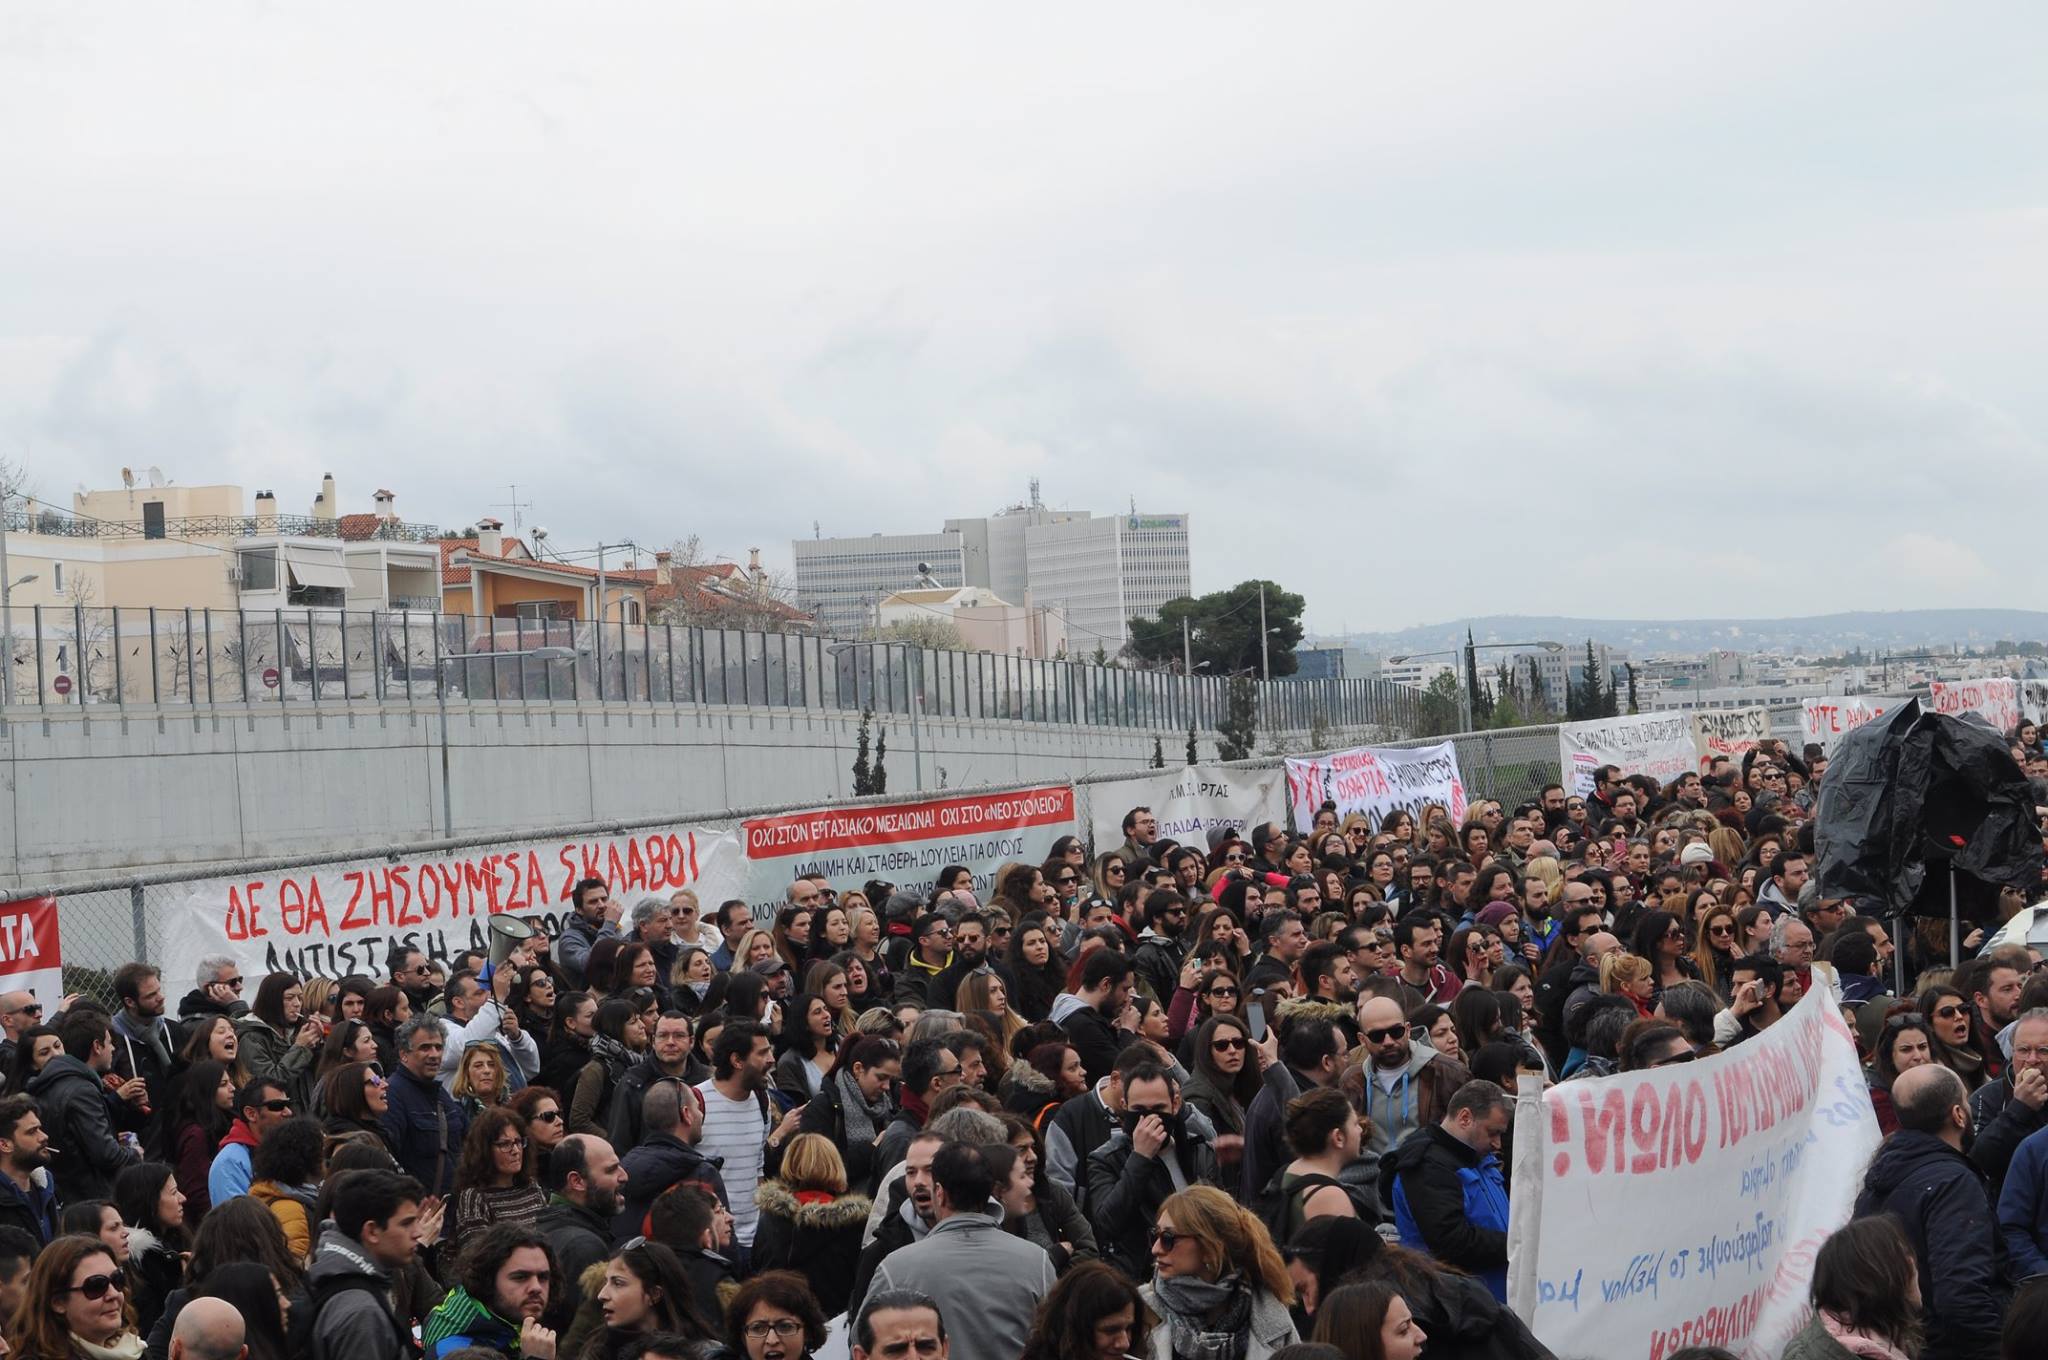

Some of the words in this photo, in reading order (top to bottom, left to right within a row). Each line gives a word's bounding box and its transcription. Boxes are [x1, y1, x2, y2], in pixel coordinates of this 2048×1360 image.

[752, 829, 775, 848] ΟΧΙ
[777, 824, 808, 846] ΣΤΟΝ
[810, 816, 874, 841] ΕΡΓΑΣΙΑΚΟ
[876, 808, 936, 835] ΜΕΣΑΙΩΝΑ!
[940, 807, 960, 827] ΟΧΙ
[961, 804, 983, 824] ΣΤΟ
[847, 856, 866, 875] ΚΑΙ
[867, 850, 918, 874] ΣΤΑΘΕΡΗ
[919, 845, 968, 868] ΔΟΥΛΕΙΑ
[969, 843, 985, 861] ΓΙΑ
[986, 837, 1024, 858] ΟΛΟΥΣ
[225, 881, 268, 941] ΔΕ
[279, 875, 331, 938] ΘΑ
[559, 831, 699, 902] ΣΚΛΑΒΟΙ
